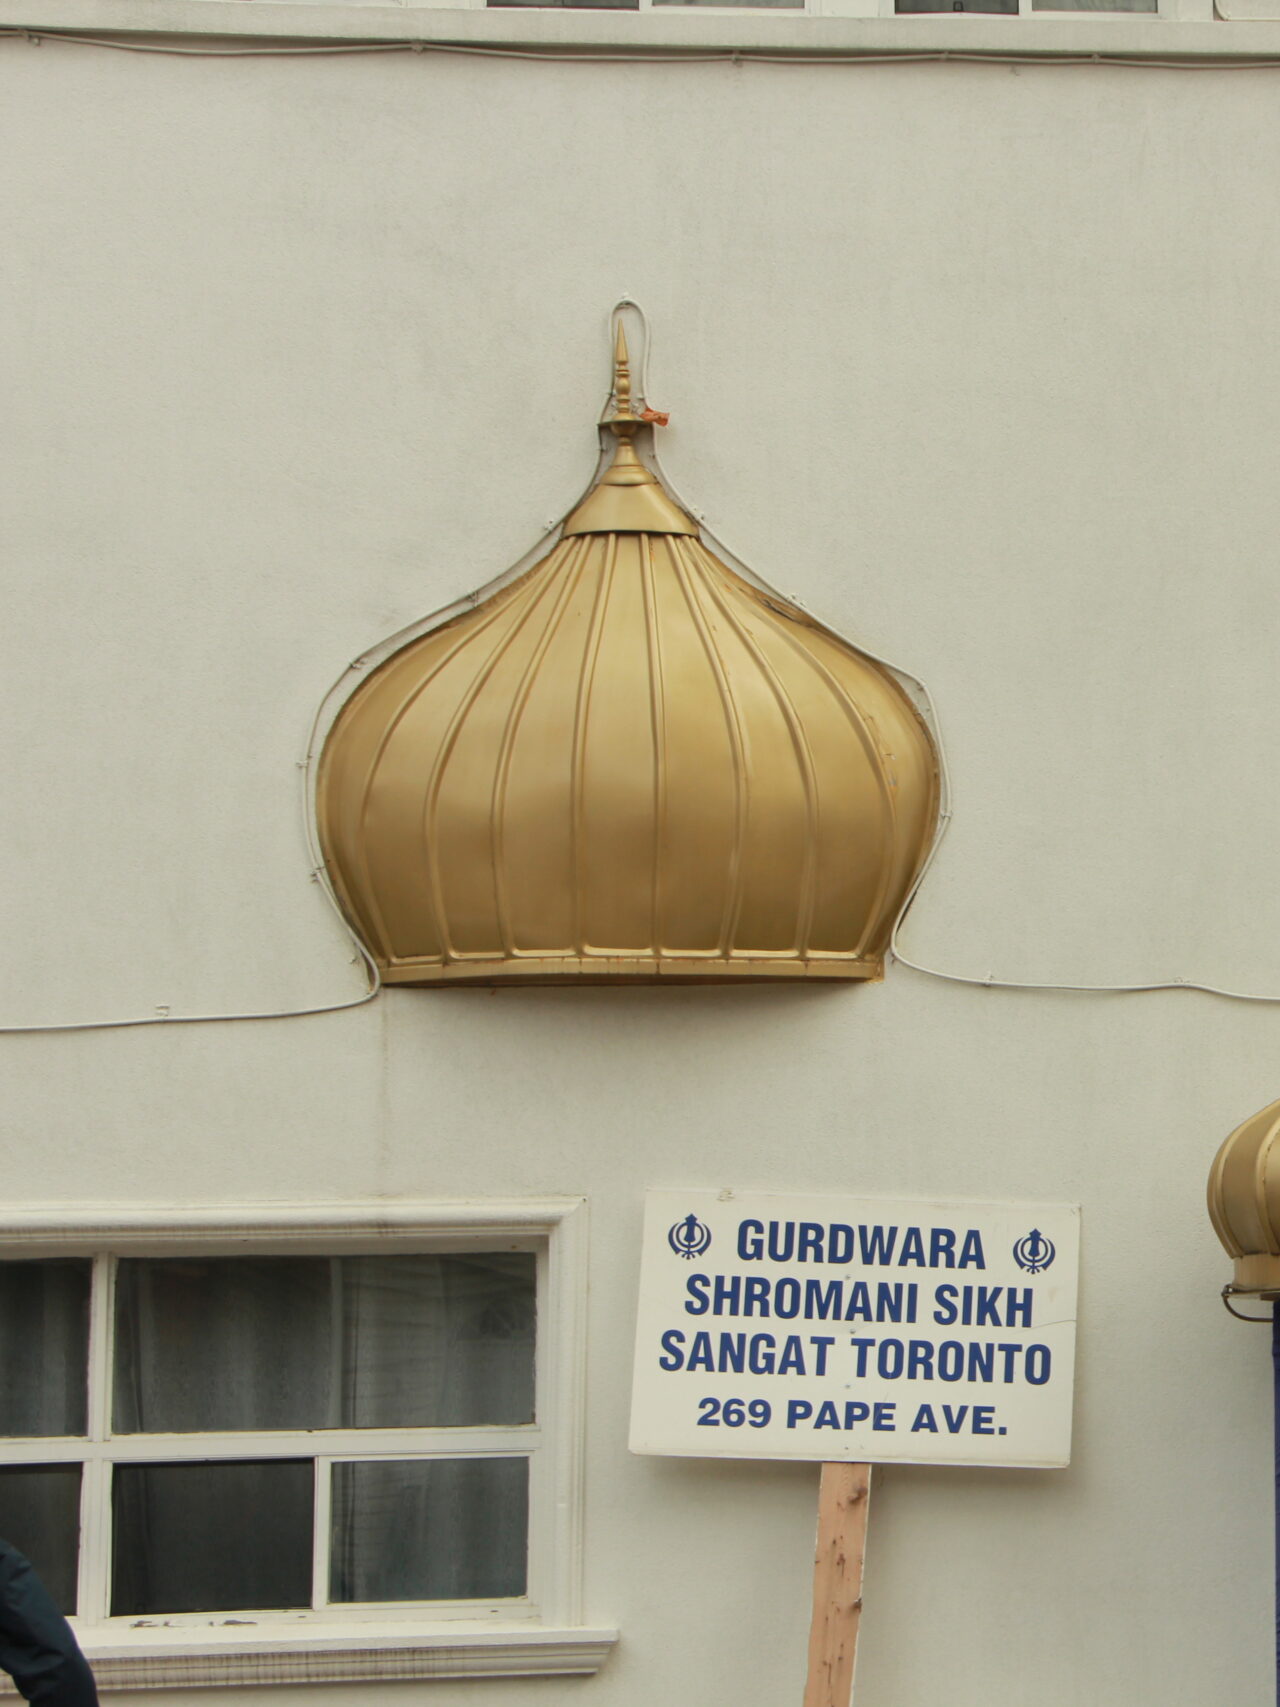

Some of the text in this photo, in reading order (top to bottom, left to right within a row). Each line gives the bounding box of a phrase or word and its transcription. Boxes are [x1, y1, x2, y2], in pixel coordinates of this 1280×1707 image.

[736, 1218, 987, 1271] GURDWARA
[684, 1273, 1034, 1329] SHROMANI SIKH
[658, 1329, 1052, 1386] SANGAT TORONTO
[696, 1397, 1008, 1437] 269 PAPE AVE.
